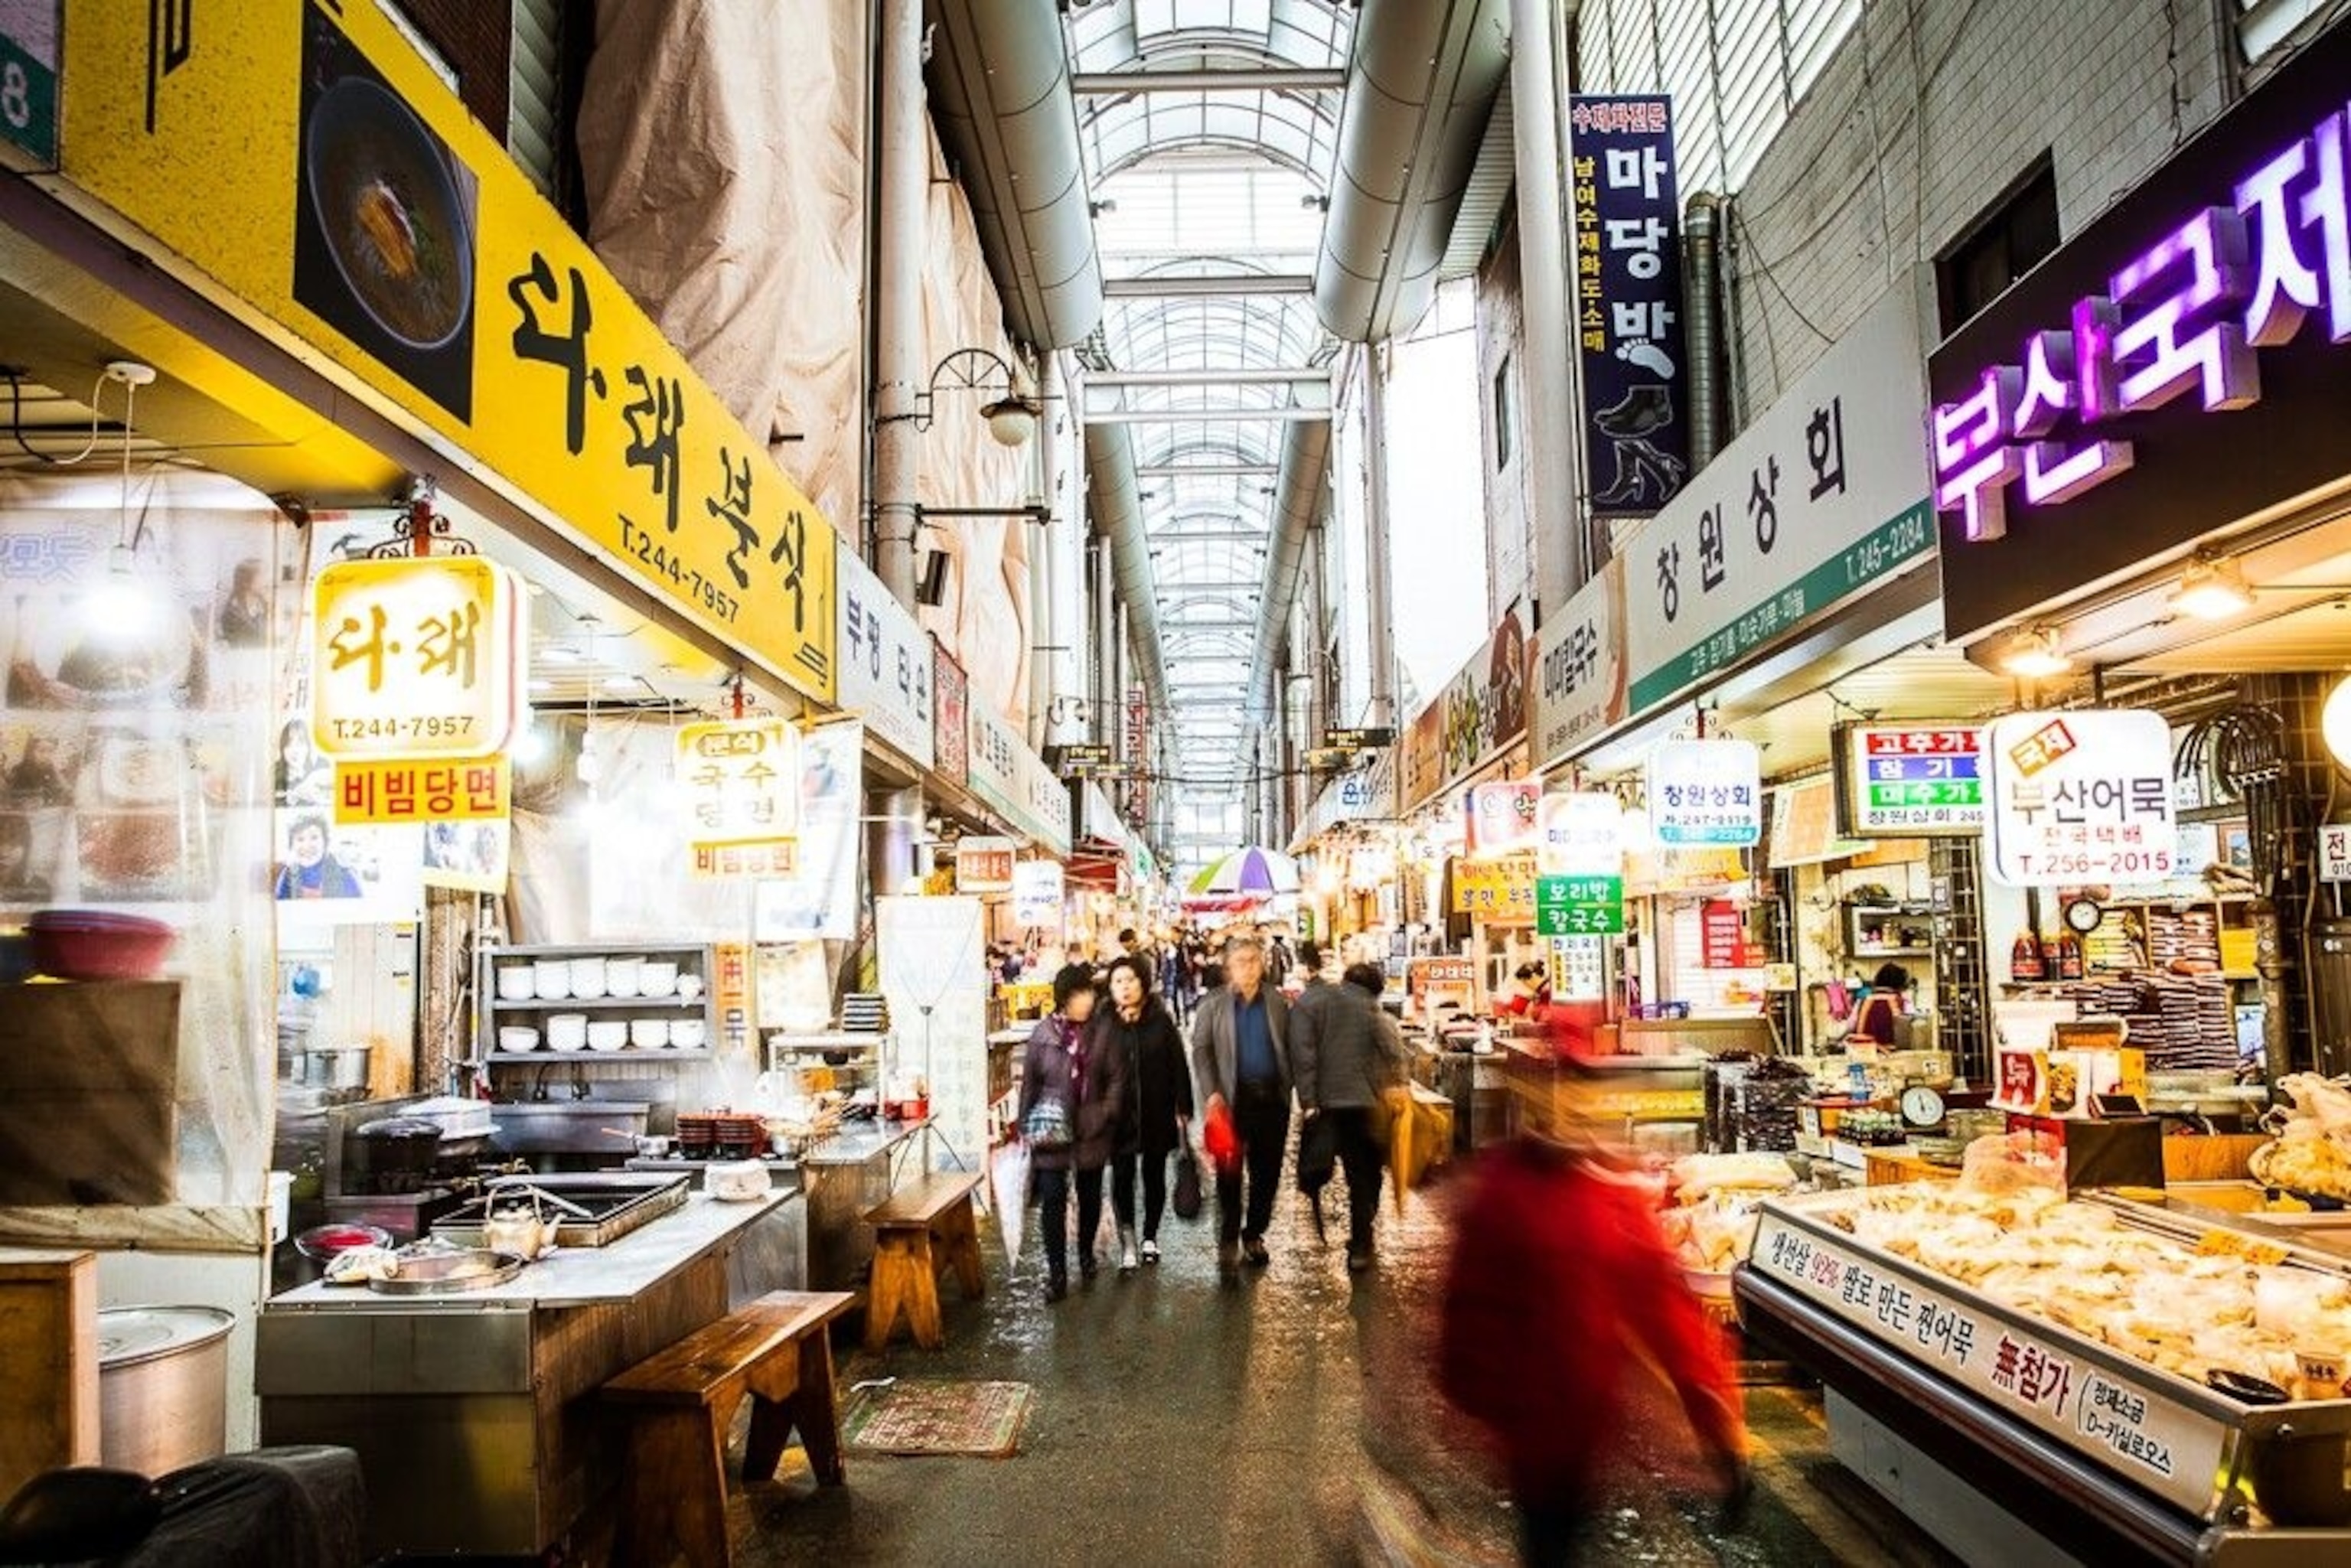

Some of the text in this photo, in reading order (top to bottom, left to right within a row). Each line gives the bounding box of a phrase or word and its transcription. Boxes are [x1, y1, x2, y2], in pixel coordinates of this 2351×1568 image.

[1657, 395, 1845, 623] 창원상회
[618, 512, 739, 624] T.244-7957
[328, 601, 480, 693] 다래
[333, 716, 474, 740] T.244-7957
[1875, 733, 1981, 753] 고추가
[344, 767, 498, 817] 비빔당면
[1664, 783, 1750, 807] 창원상회
[2012, 777, 2167, 824] 부산어묵
[2020, 852, 2170, 875] T.256-2015
[1548, 880, 1611, 902] 보리밥
[1547, 908, 1609, 933] 칼국수
[1772, 1233, 1811, 1277] 생선살
[1843, 1264, 1874, 1307] 쌀로
[1878, 1283, 1912, 1331] 만든
[1916, 1302, 1974, 1365] 찐어묵
[2094, 1381, 2144, 1425] 정제소금
